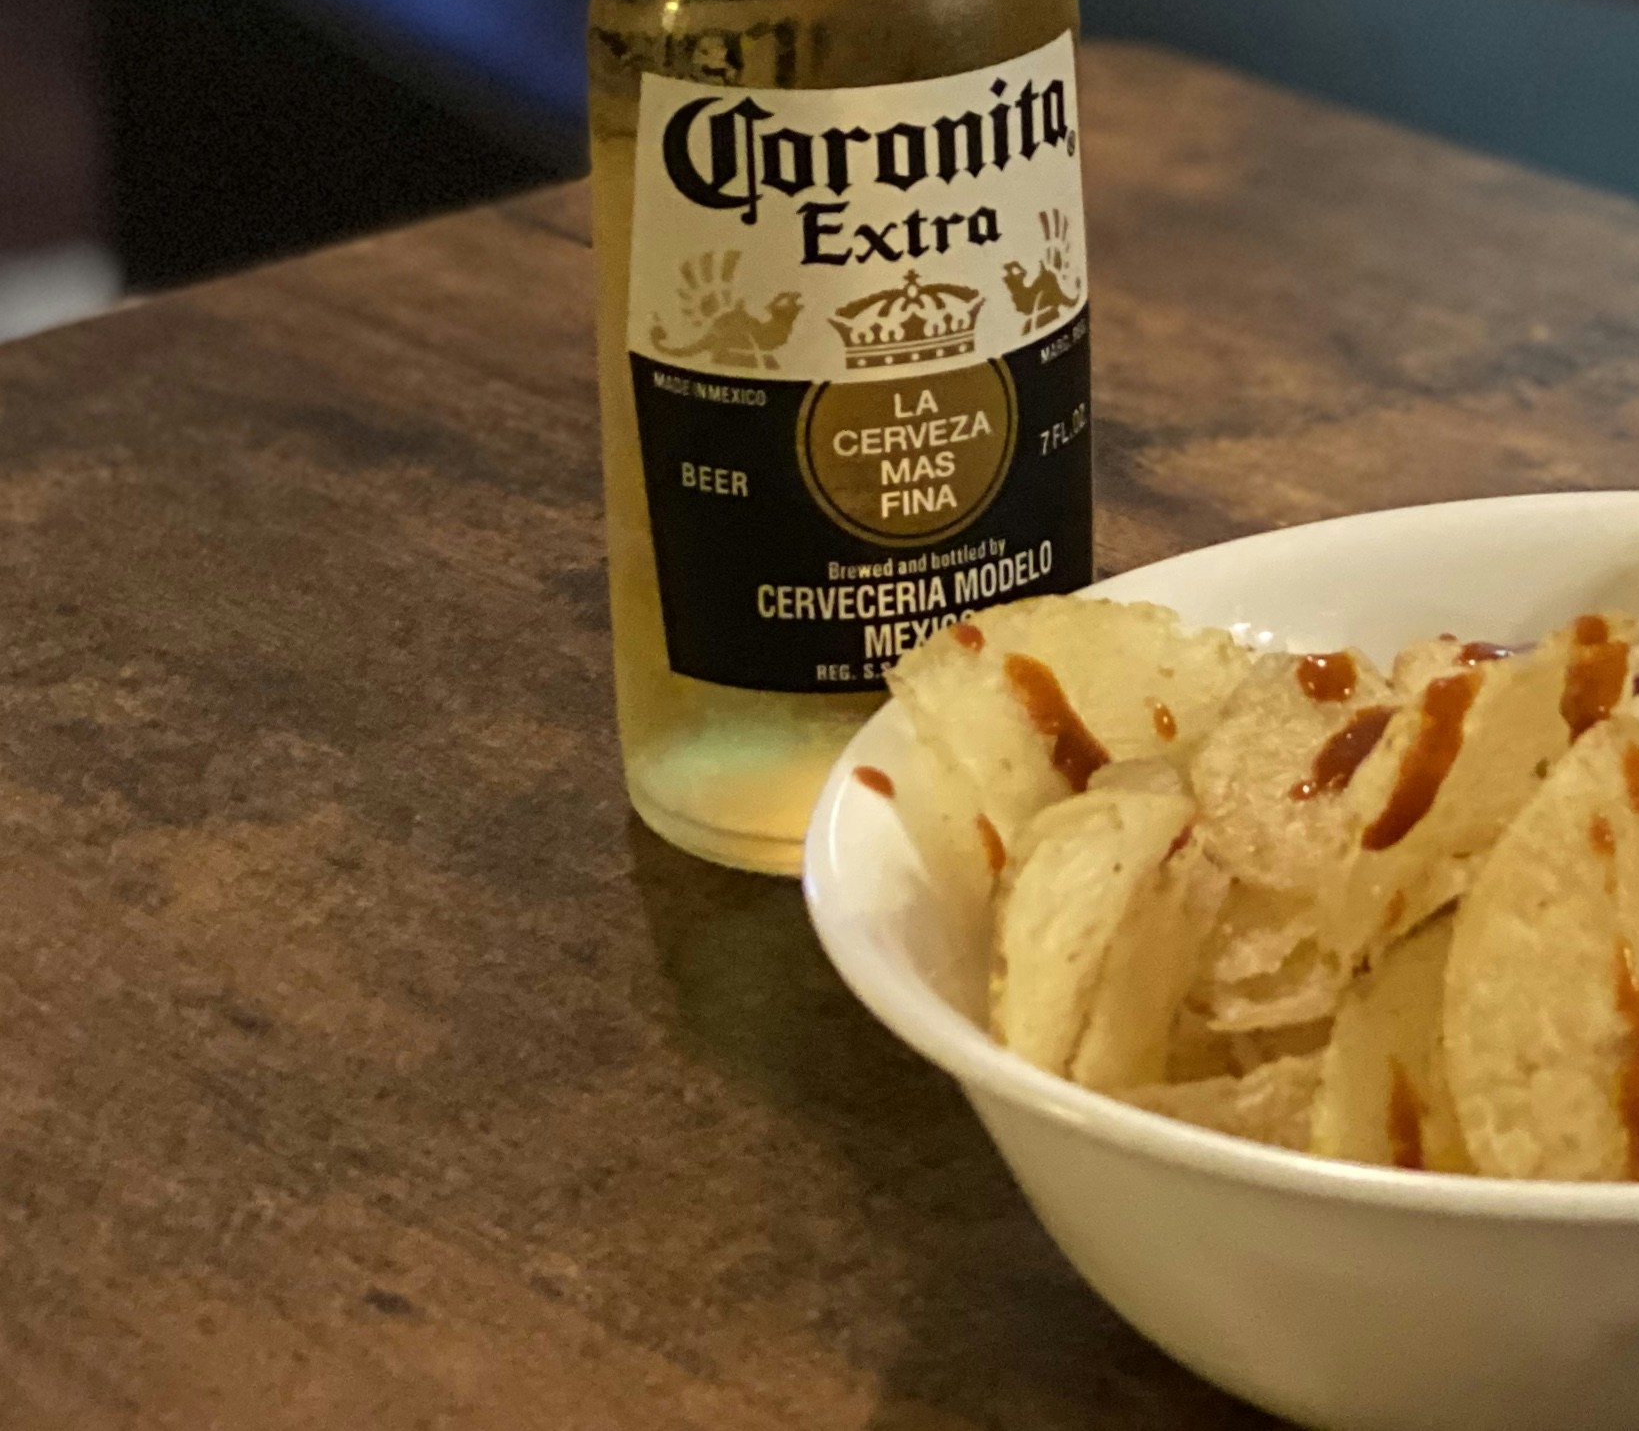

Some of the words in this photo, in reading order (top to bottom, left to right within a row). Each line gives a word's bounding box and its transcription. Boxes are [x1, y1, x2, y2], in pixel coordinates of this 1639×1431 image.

[661, 77, 1070, 225] Coronita
[797, 201, 1001, 266] Extra
[707, 384, 768, 407] MEXICO
[894, 389, 940, 419] LA
[832, 410, 993, 458] CERVEZA
[1040, 429, 1051, 457] 7
[681, 461, 750, 498] BEER
[880, 451, 956, 486] MAS
[881, 484, 958, 519] FINA
[828, 557, 894, 581] Brewed
[897, 553, 927, 576] and
[931, 540, 986, 568] bottled
[988, 536, 1007, 557] by
[757, 575, 947, 620] CERVECERIA
[954, 539, 1053, 605] MODELO
